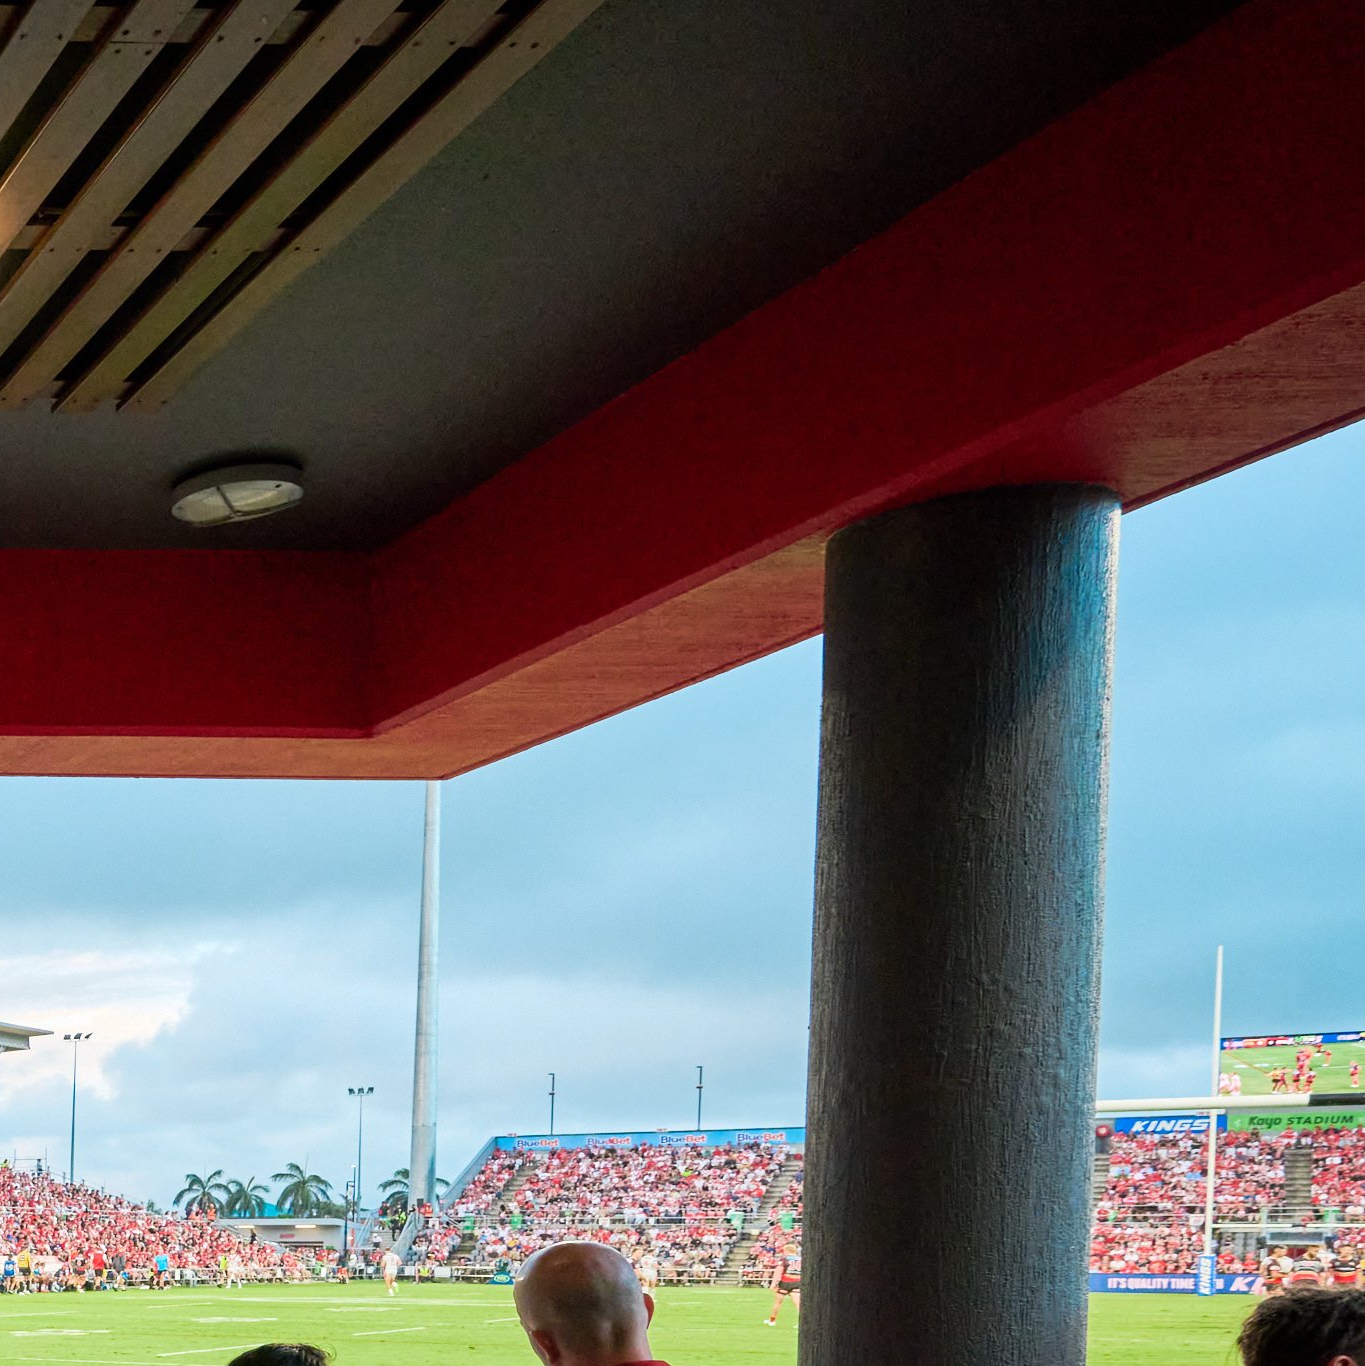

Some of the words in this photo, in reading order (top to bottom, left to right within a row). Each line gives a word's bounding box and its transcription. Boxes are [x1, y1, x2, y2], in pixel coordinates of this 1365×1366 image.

[1132, 1119, 1210, 1132] KINGS
[1248, 1115, 1282, 1129] Kayo
[1287, 1115, 1354, 1125] STADIUM
[516, 1138, 561, 1148] BlueBet
[660, 1135, 705, 1144] BlueBet
[737, 1133, 785, 1142] BlueBet
[1128, 1278, 1169, 1290] QUALITY
[1171, 1278, 1194, 1289] TIME
